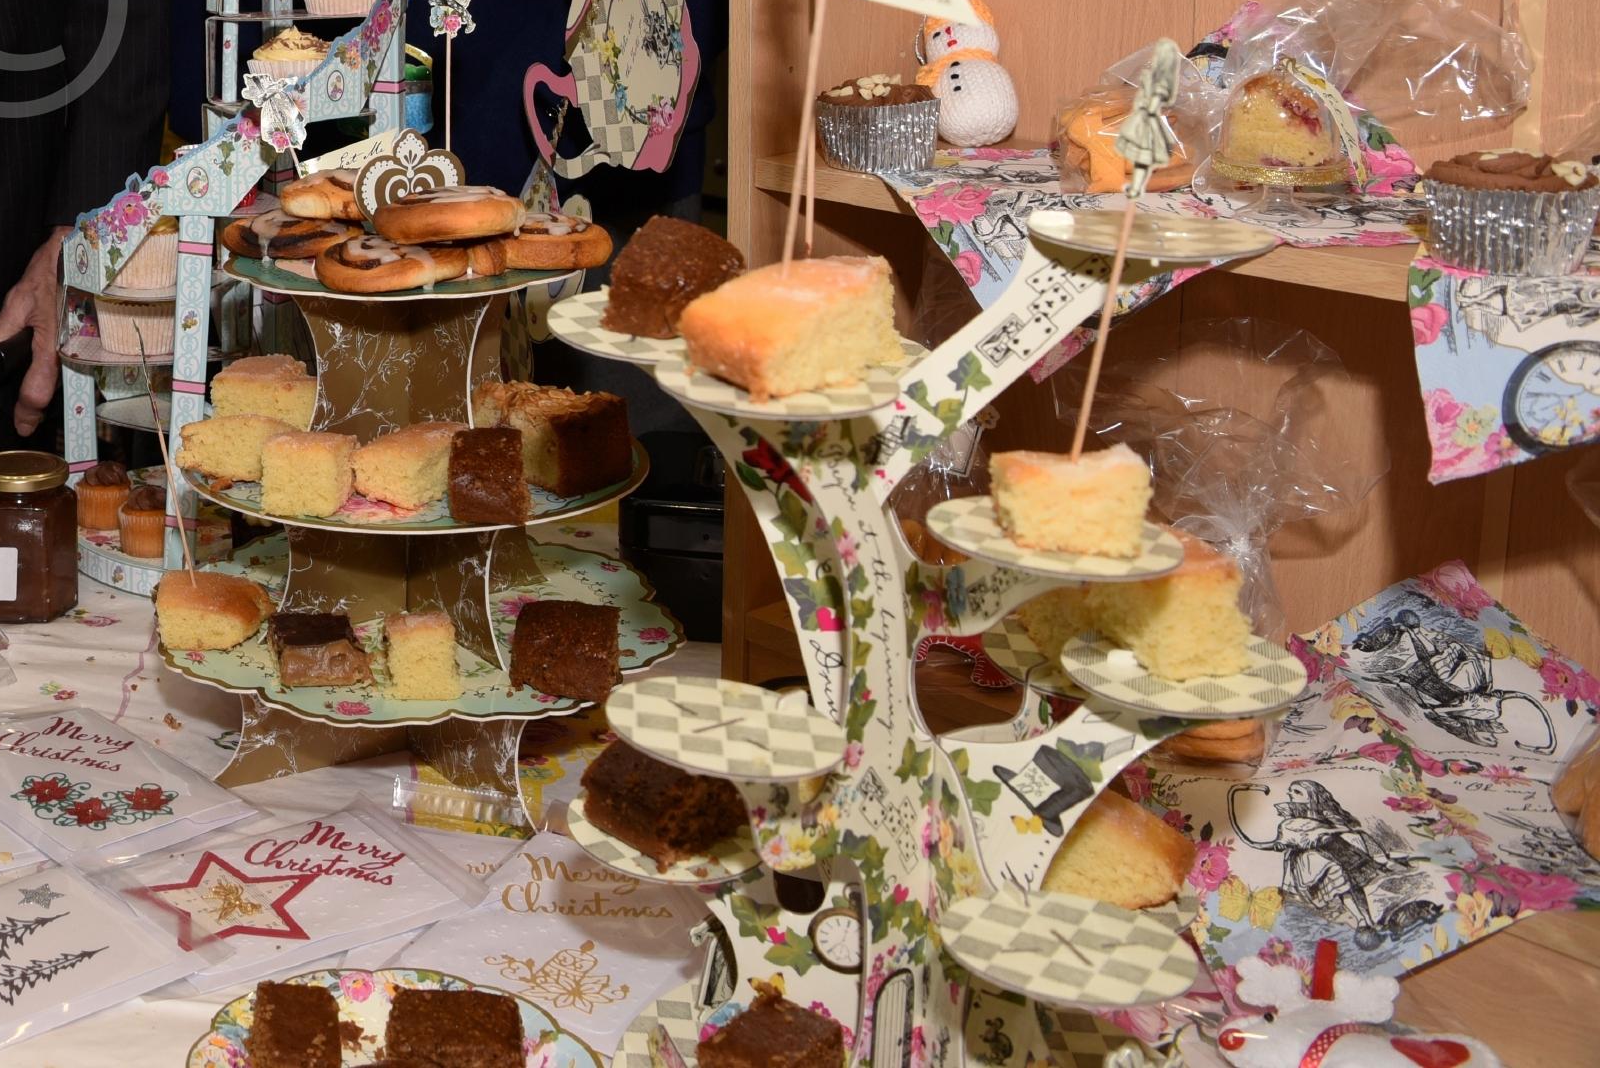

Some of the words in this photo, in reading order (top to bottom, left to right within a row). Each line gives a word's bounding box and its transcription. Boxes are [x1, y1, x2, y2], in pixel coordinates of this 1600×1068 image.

[857, 518, 880, 545] at
[869, 550, 893, 596] the
[42, 716, 135, 755] Merry
[244, 839, 394, 886] Christmas
[299, 820, 407, 870] Merry
[517, 852, 641, 896] Merry
[501, 881, 674, 918] Christmas
